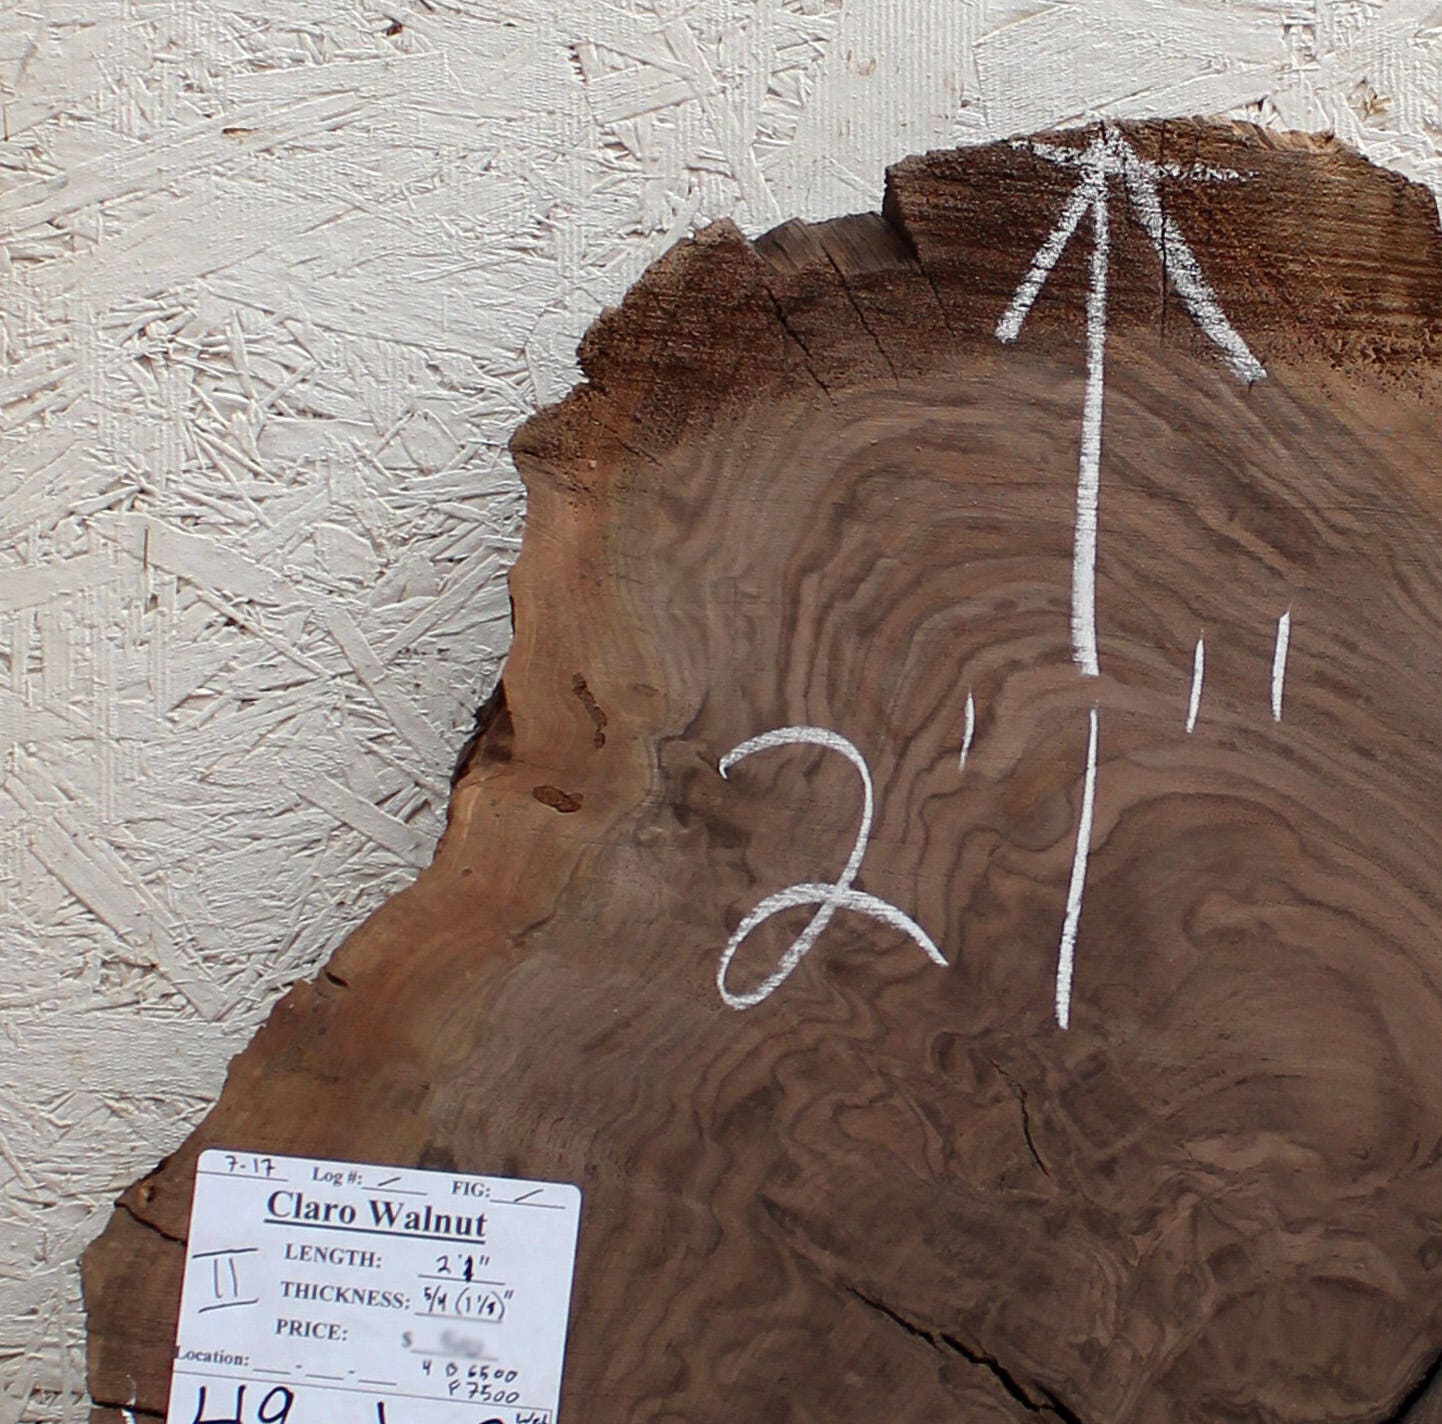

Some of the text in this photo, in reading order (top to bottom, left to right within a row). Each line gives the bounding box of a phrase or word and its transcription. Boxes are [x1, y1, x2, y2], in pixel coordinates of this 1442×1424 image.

[224, 1154, 276, 1178] 7-17
[311, 1166, 344, 1186] Log
[451, 1180, 492, 1199] FIG:
[266, 1189, 488, 1238] Claro Walnut
[284, 1242, 383, 1269] LENGTH:
[279, 1280, 412, 1310] THICKNESS:
[274, 1317, 349, 1343] PRICE:
[171, 1345, 250, 1367] Location:
[465, 1380, 521, 1405] 7500
